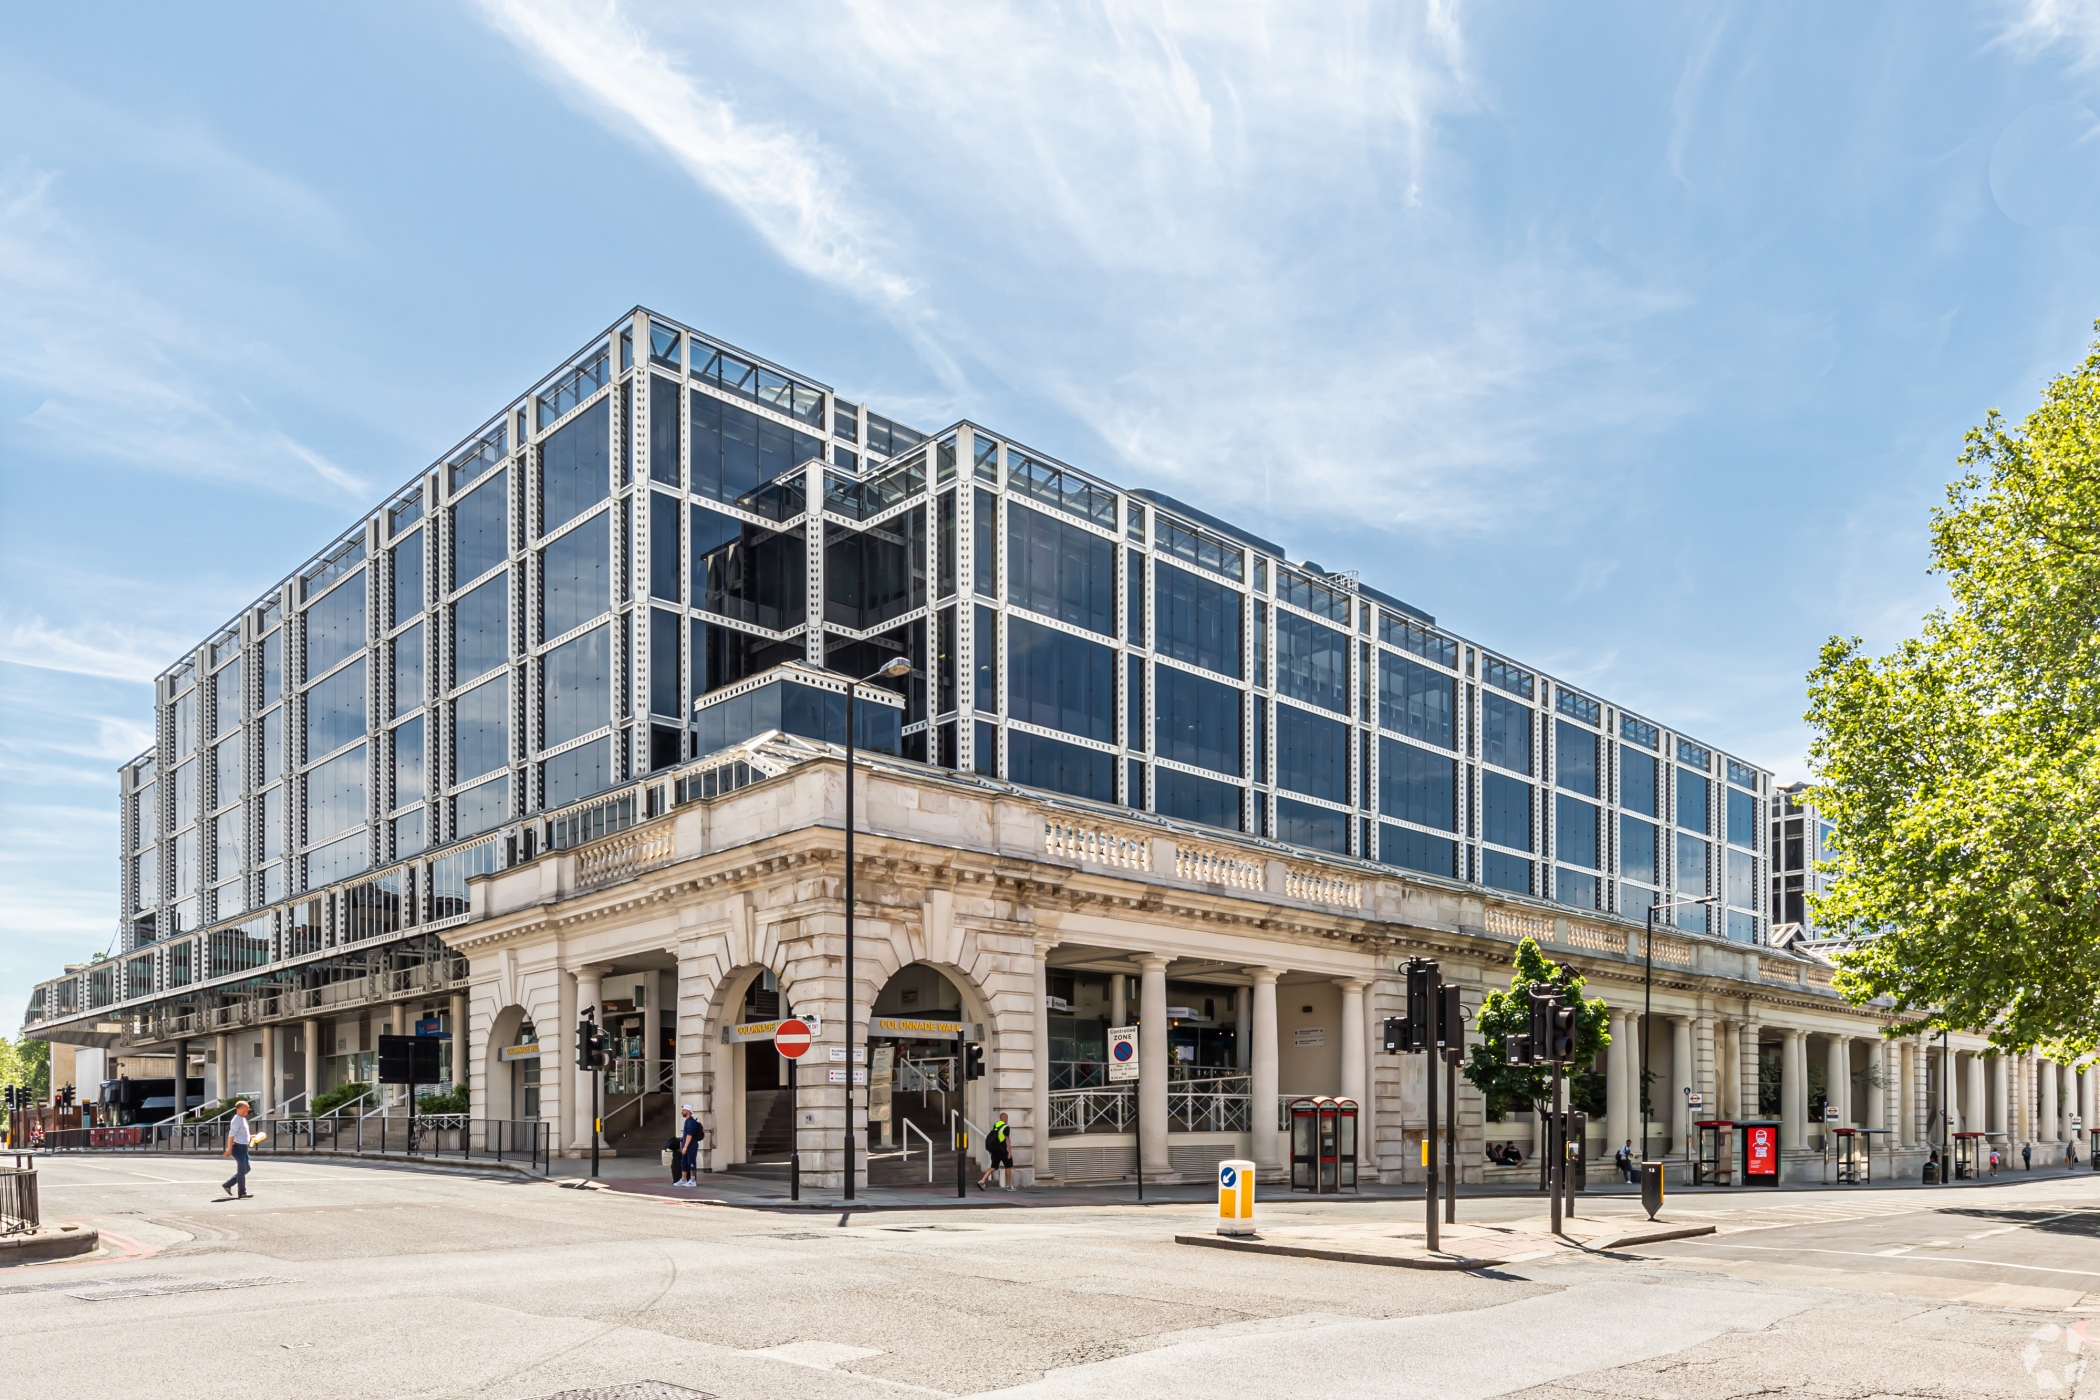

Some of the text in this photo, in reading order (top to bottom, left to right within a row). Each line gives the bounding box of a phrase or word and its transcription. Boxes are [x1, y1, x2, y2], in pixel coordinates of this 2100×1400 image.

[736, 1022, 775, 1035] COLONNADE
[880, 1019, 962, 1033] COLONNADE WALK
